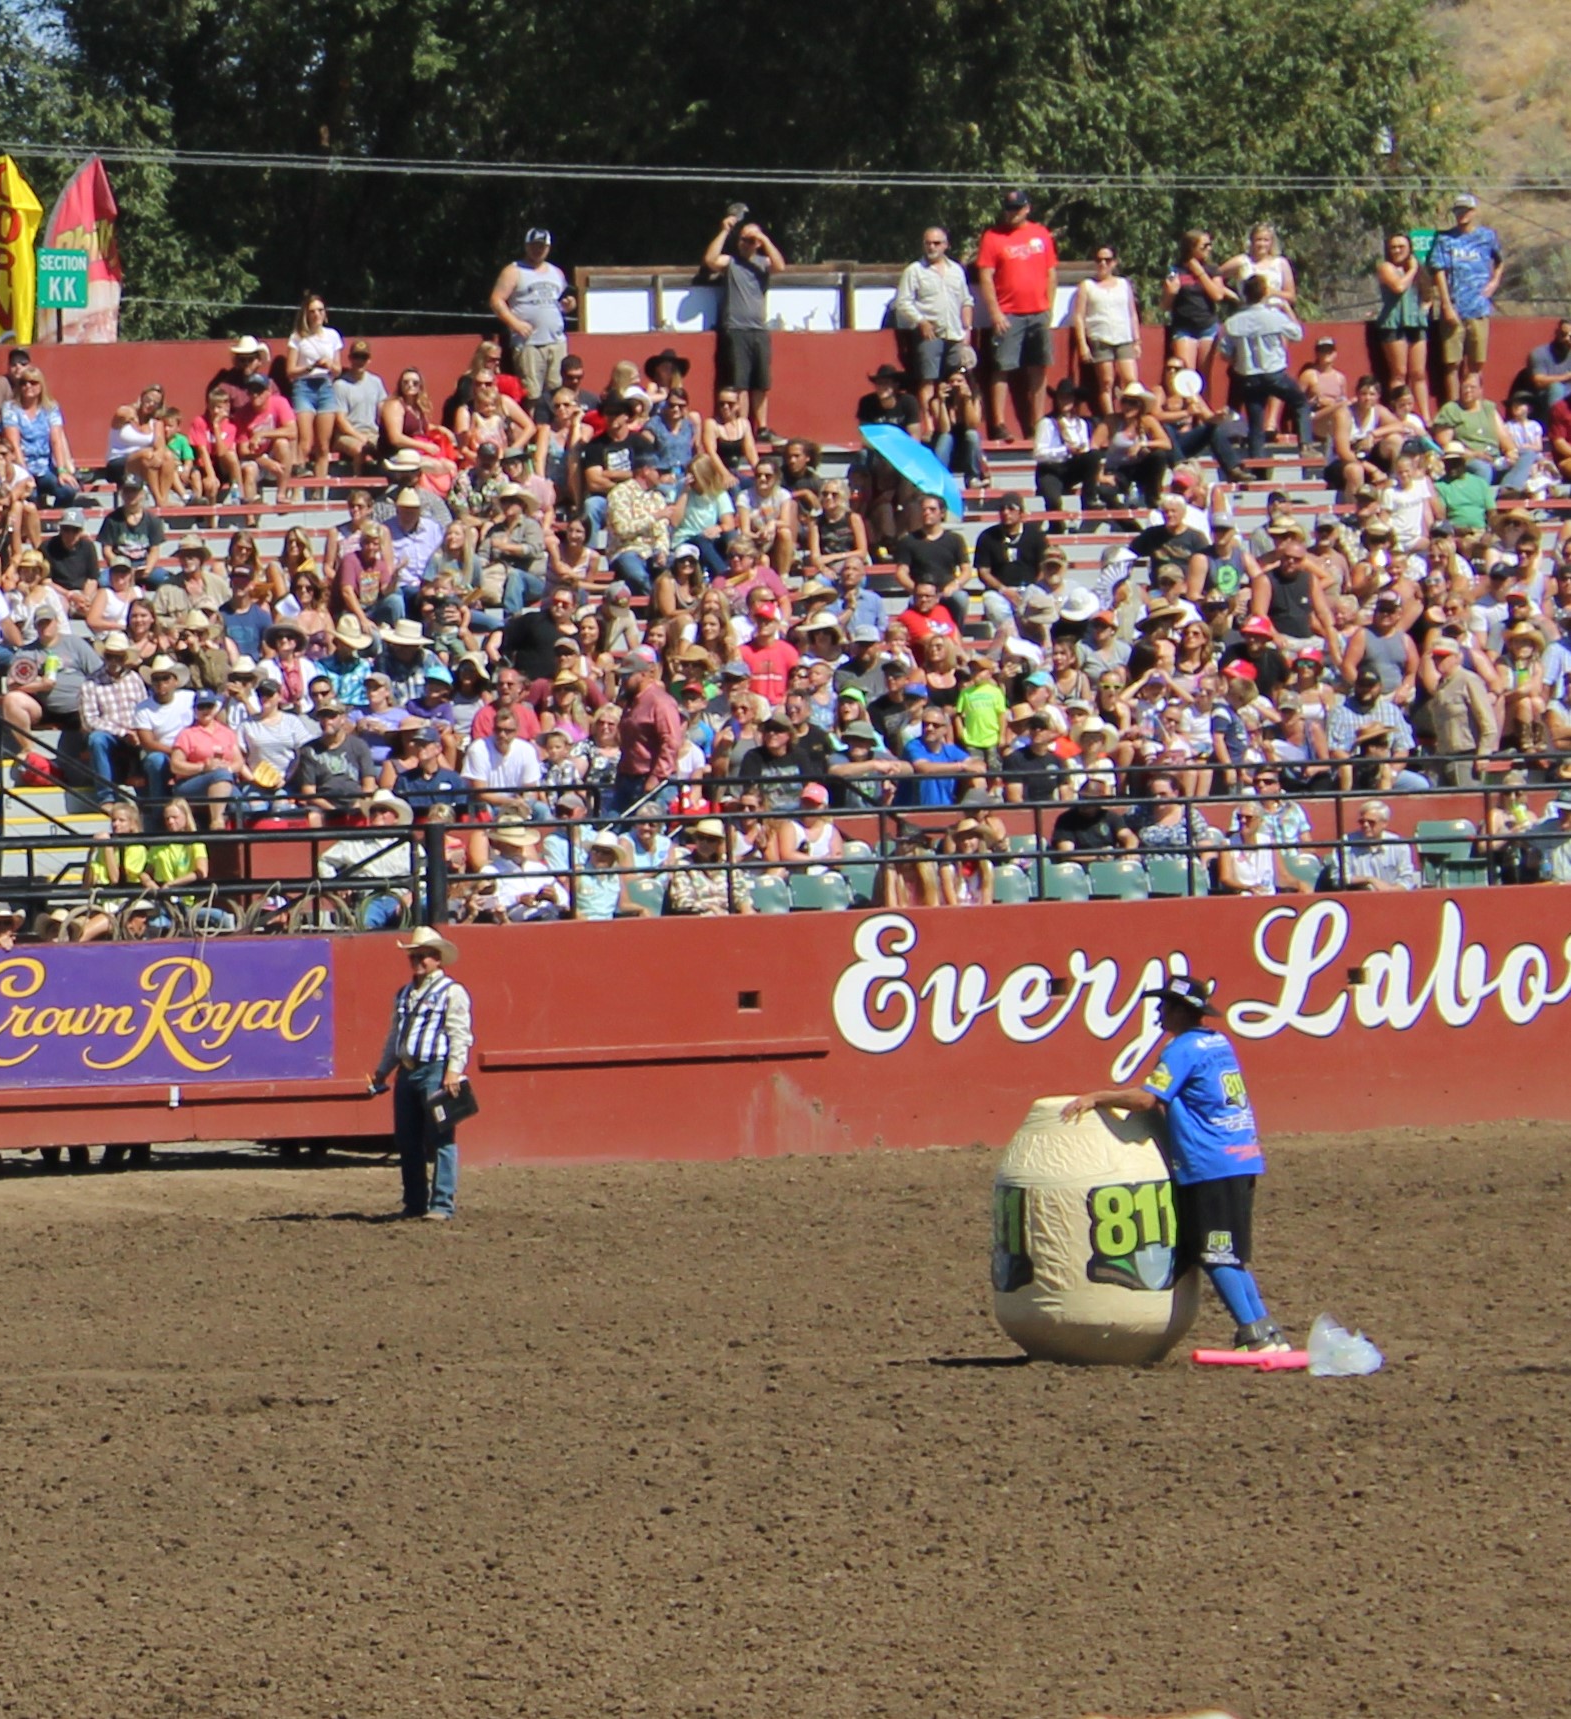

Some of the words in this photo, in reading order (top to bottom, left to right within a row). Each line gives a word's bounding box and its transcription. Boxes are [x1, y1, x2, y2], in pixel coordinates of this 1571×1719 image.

[40, 255, 87, 271] SECTION
[48, 276, 77, 302] KK
[82, 956, 329, 1072] Royal
[833, 912, 1216, 1084] Every
[1226, 898, 1571, 1039] Labo
[1093, 1180, 1177, 1257] 811
